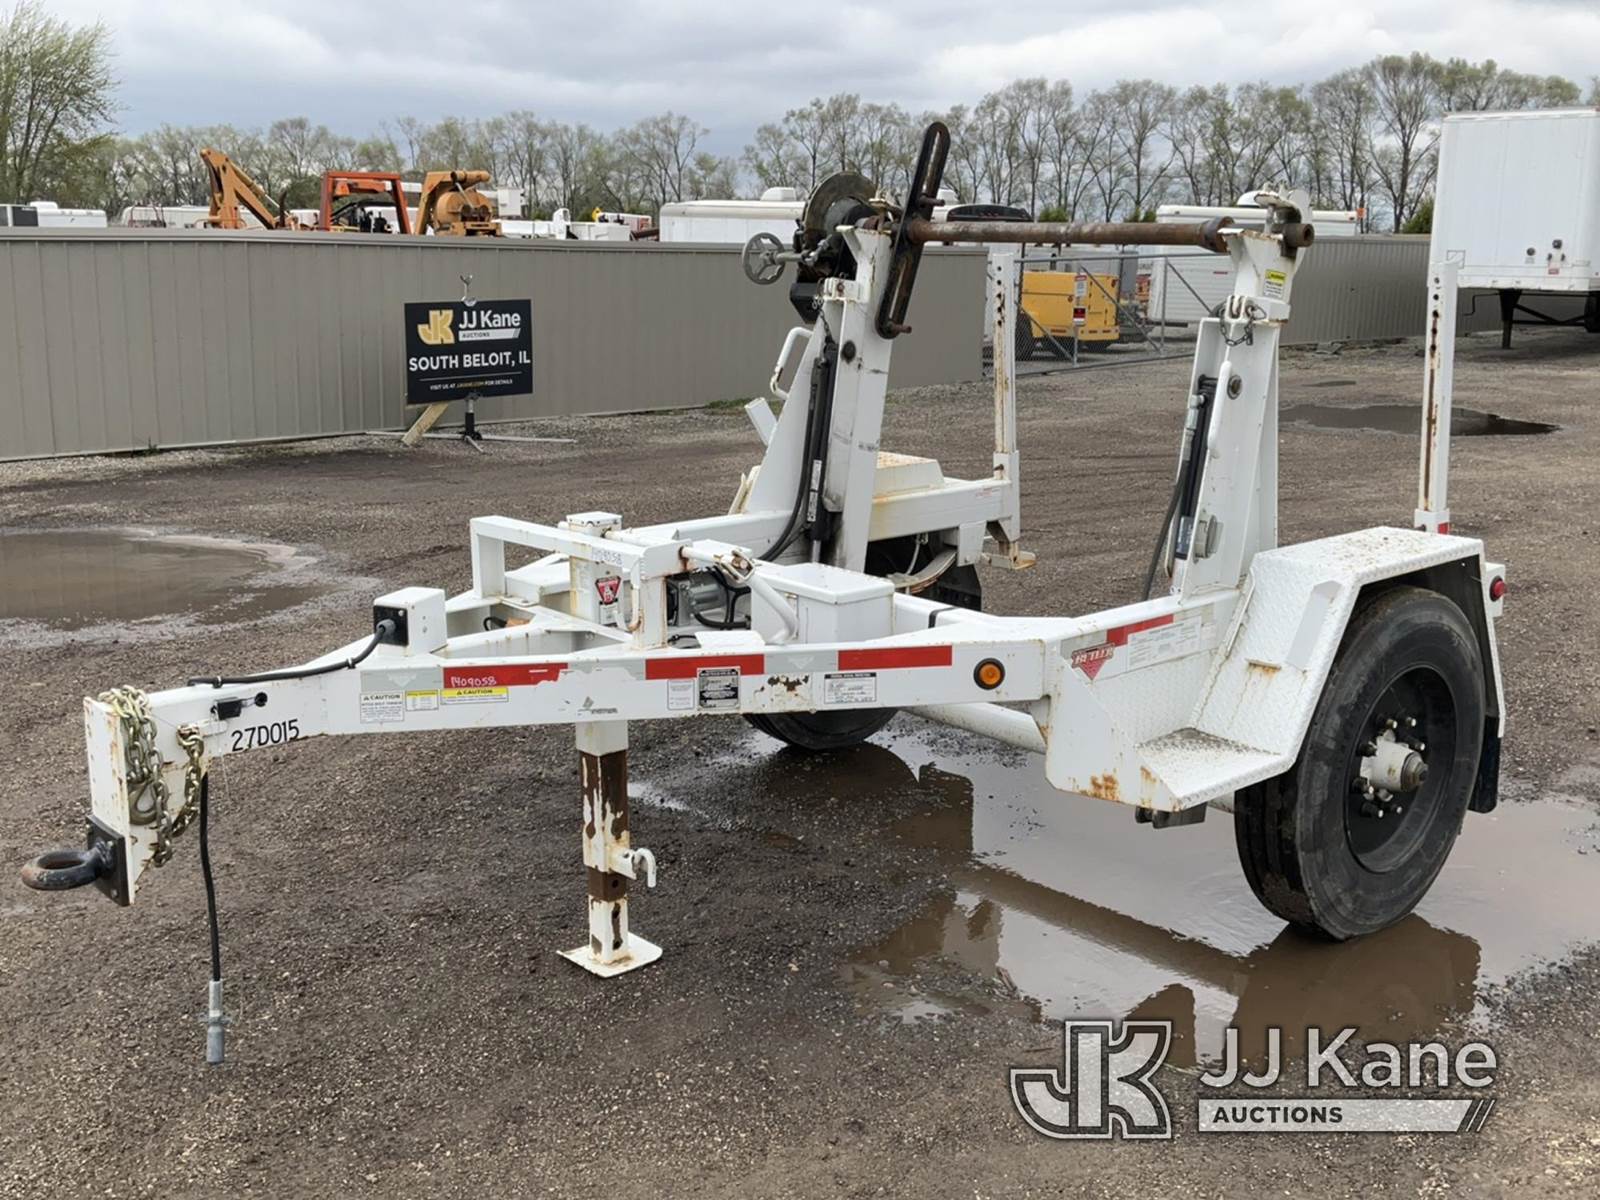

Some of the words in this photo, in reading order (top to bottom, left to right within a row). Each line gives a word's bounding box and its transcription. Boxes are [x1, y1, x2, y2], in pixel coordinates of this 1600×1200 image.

[459, 310, 477, 329] JJ
[480, 310, 521, 328] Kane
[408, 355, 459, 372] SOUTH
[463, 351, 515, 368] BELOIT,
[519, 350, 531, 364] IL
[231, 718, 300, 752] 27D015
